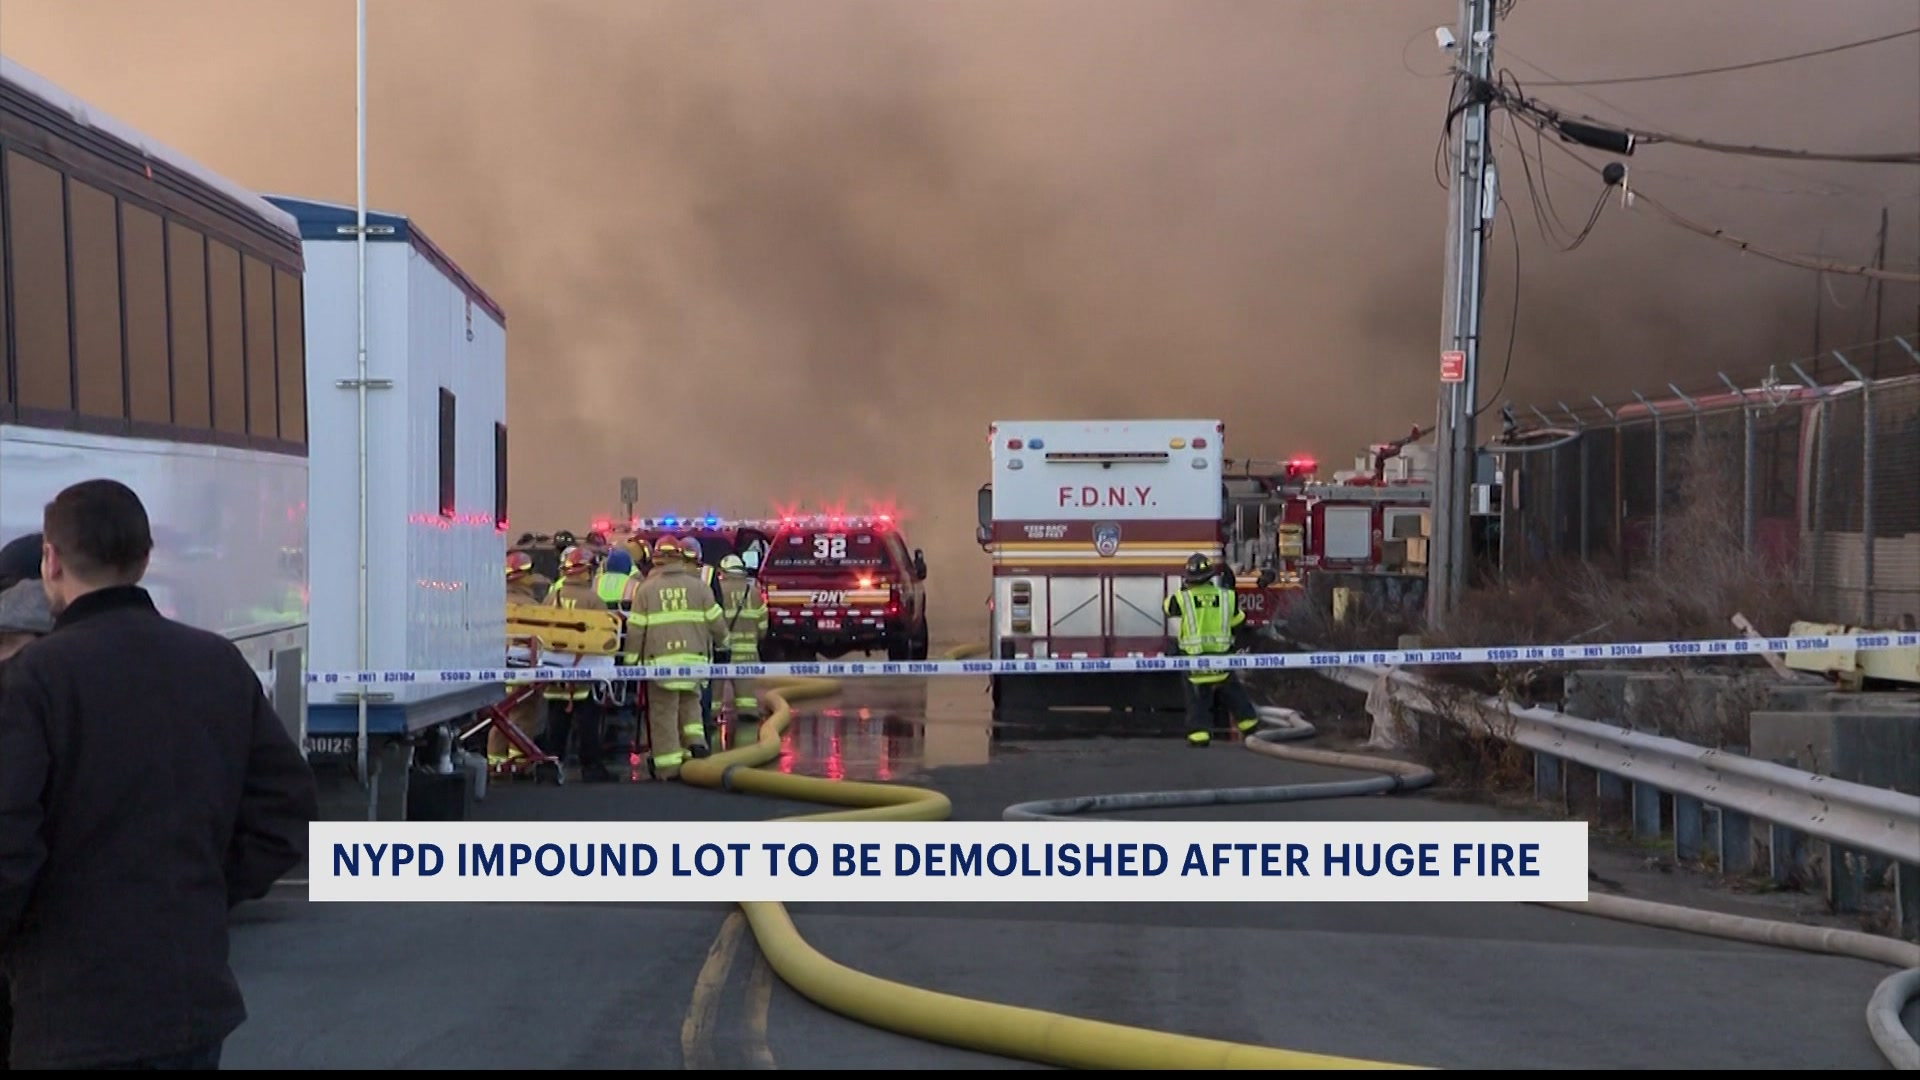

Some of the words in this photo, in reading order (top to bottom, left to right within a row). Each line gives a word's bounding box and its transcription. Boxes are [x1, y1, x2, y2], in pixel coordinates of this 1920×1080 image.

[1058, 486, 1157, 508] F.D.N.Y.
[810, 590, 848, 603] FDNY
[1239, 594, 1264, 610] 202
[1768, 640, 1788, 650] LINE
[1796, 639, 1829, 650] POLICE
[1856, 637, 1889, 648] CROSS
[1897, 636, 1916, 646] NOT
[1669, 643, 1700, 653] CROSS
[1709, 642, 1727, 652] NOT
[1735, 641, 1748, 651] DO
[1487, 650, 1518, 660] CROSS
[1526, 649, 1543, 658] NOT
[1552, 648, 1565, 657] DO
[1584, 647, 1602, 656] LINE
[1611, 646, 1642, 656] POLICE
[1310, 655, 1340, 664] CROSS
[1348, 655, 1365, 664] NOT
[1373, 654, 1386, 663] DO
[1404, 653, 1423, 662] LINE
[1431, 652, 1462, 661] POLICE
[1056, 661, 1073, 670] LINE
[1081, 661, 1111, 670] POLICE
[1136, 660, 1166, 669] CROSS
[1173, 660, 1190, 668] NOT
[1197, 659, 1210, 668] DO
[1229, 658, 1247, 667] LINE
[1255, 657, 1285, 666] POLICE
[710, 665, 728, 675] LINE
[736, 664, 766, 675] POLICE
[790, 664, 819, 674] CROSS
[827, 664, 844, 673] NOT
[852, 663, 864, 673] DO
[883, 663, 900, 673] LINE
[909, 663, 938, 673] POLICE
[963, 662, 992, 672] CROSS
[1000, 662, 1017, 671] NOT
[1024, 662, 1036, 671] DO
[440, 671, 471, 681] CROSS
[479, 671, 496, 680] NOT
[503, 671, 516, 680] DO
[535, 670, 553, 679] LINE
[561, 669, 592, 679] POLICE
[617, 668, 647, 677] CROSS
[654, 667, 671, 676] NOT
[678, 667, 691, 676] DO
[325, 673, 338, 683] DO
[358, 672, 376, 682] LINE
[384, 672, 415, 682] POLICE
